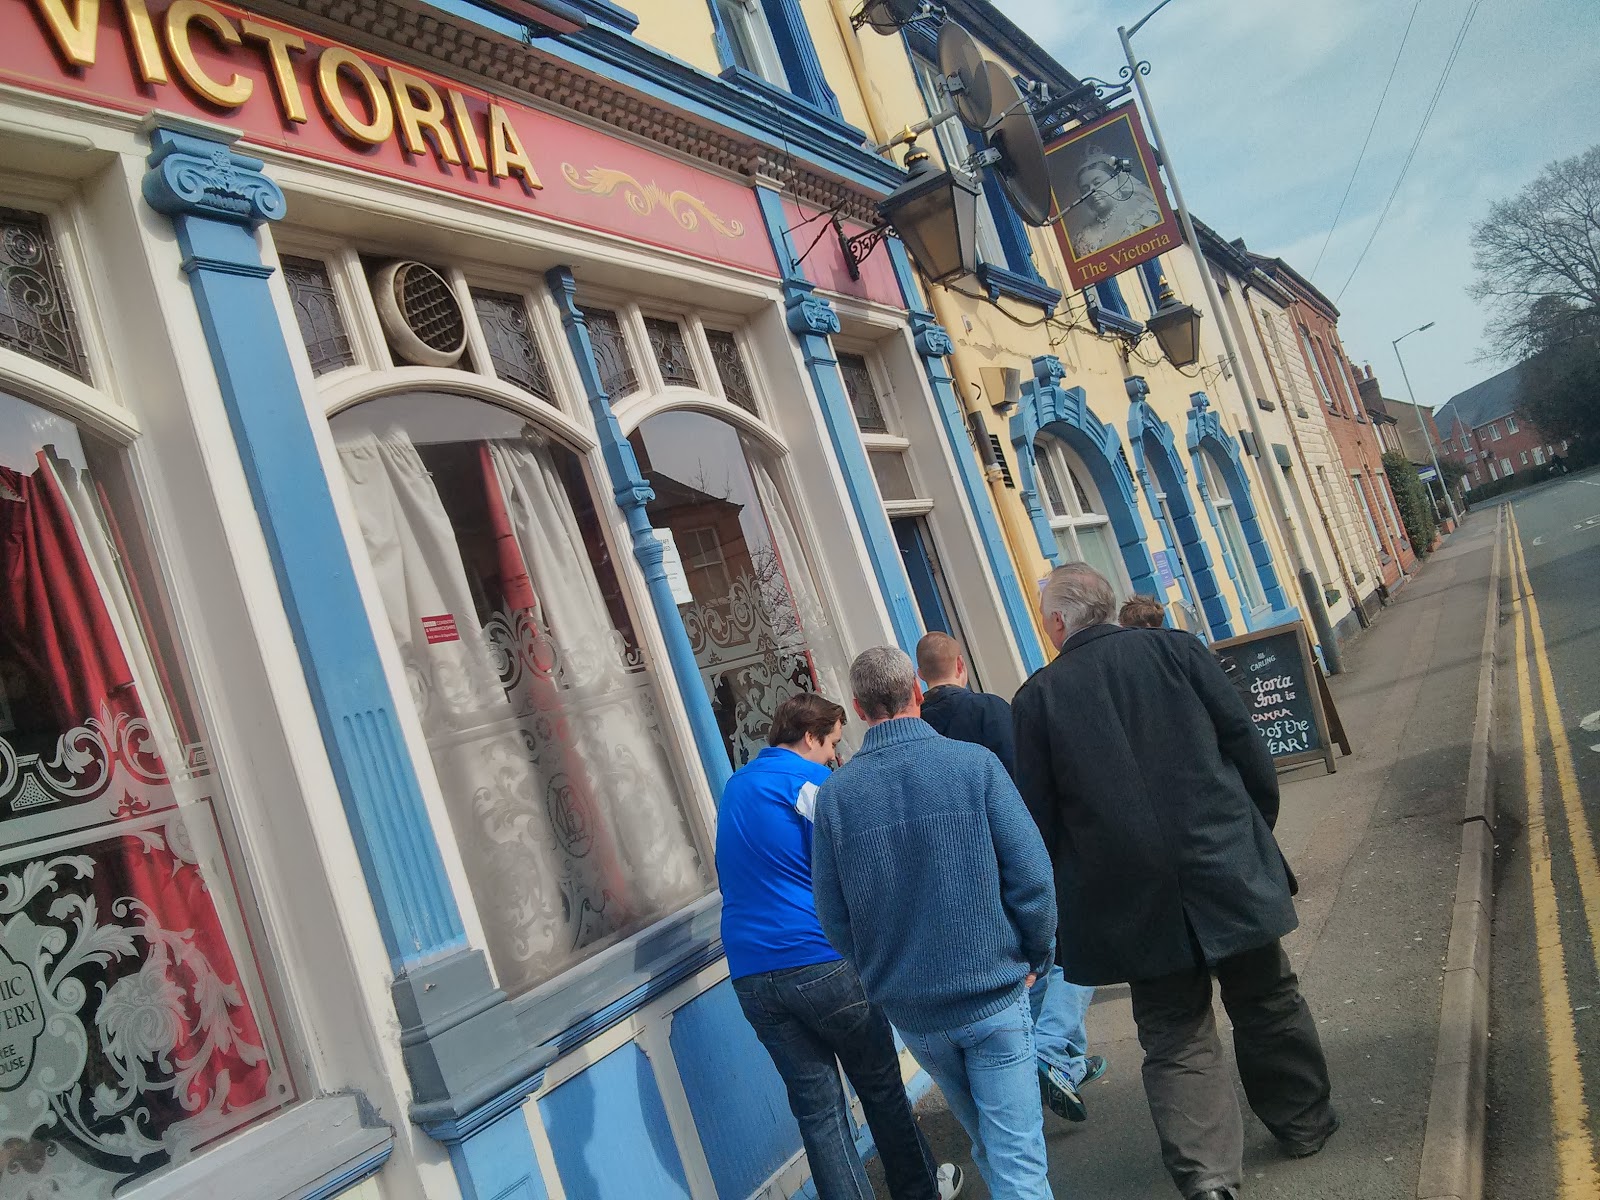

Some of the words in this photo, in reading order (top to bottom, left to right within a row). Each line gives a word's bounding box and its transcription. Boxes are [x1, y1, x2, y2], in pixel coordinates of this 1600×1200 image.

[35, 0, 543, 190] VICTORIA
[1077, 261, 1108, 280] The
[1109, 233, 1171, 266] Victoria
[1250, 654, 1276, 672] CARLING
[1250, 674, 1294, 694] ctoria
[1284, 690, 1296, 701] is
[1251, 708, 1294, 723] CAMRA
[1266, 720, 1283, 738] of
[1284, 719, 1310, 735] the
[1, 1000, 37, 1030] ERY
